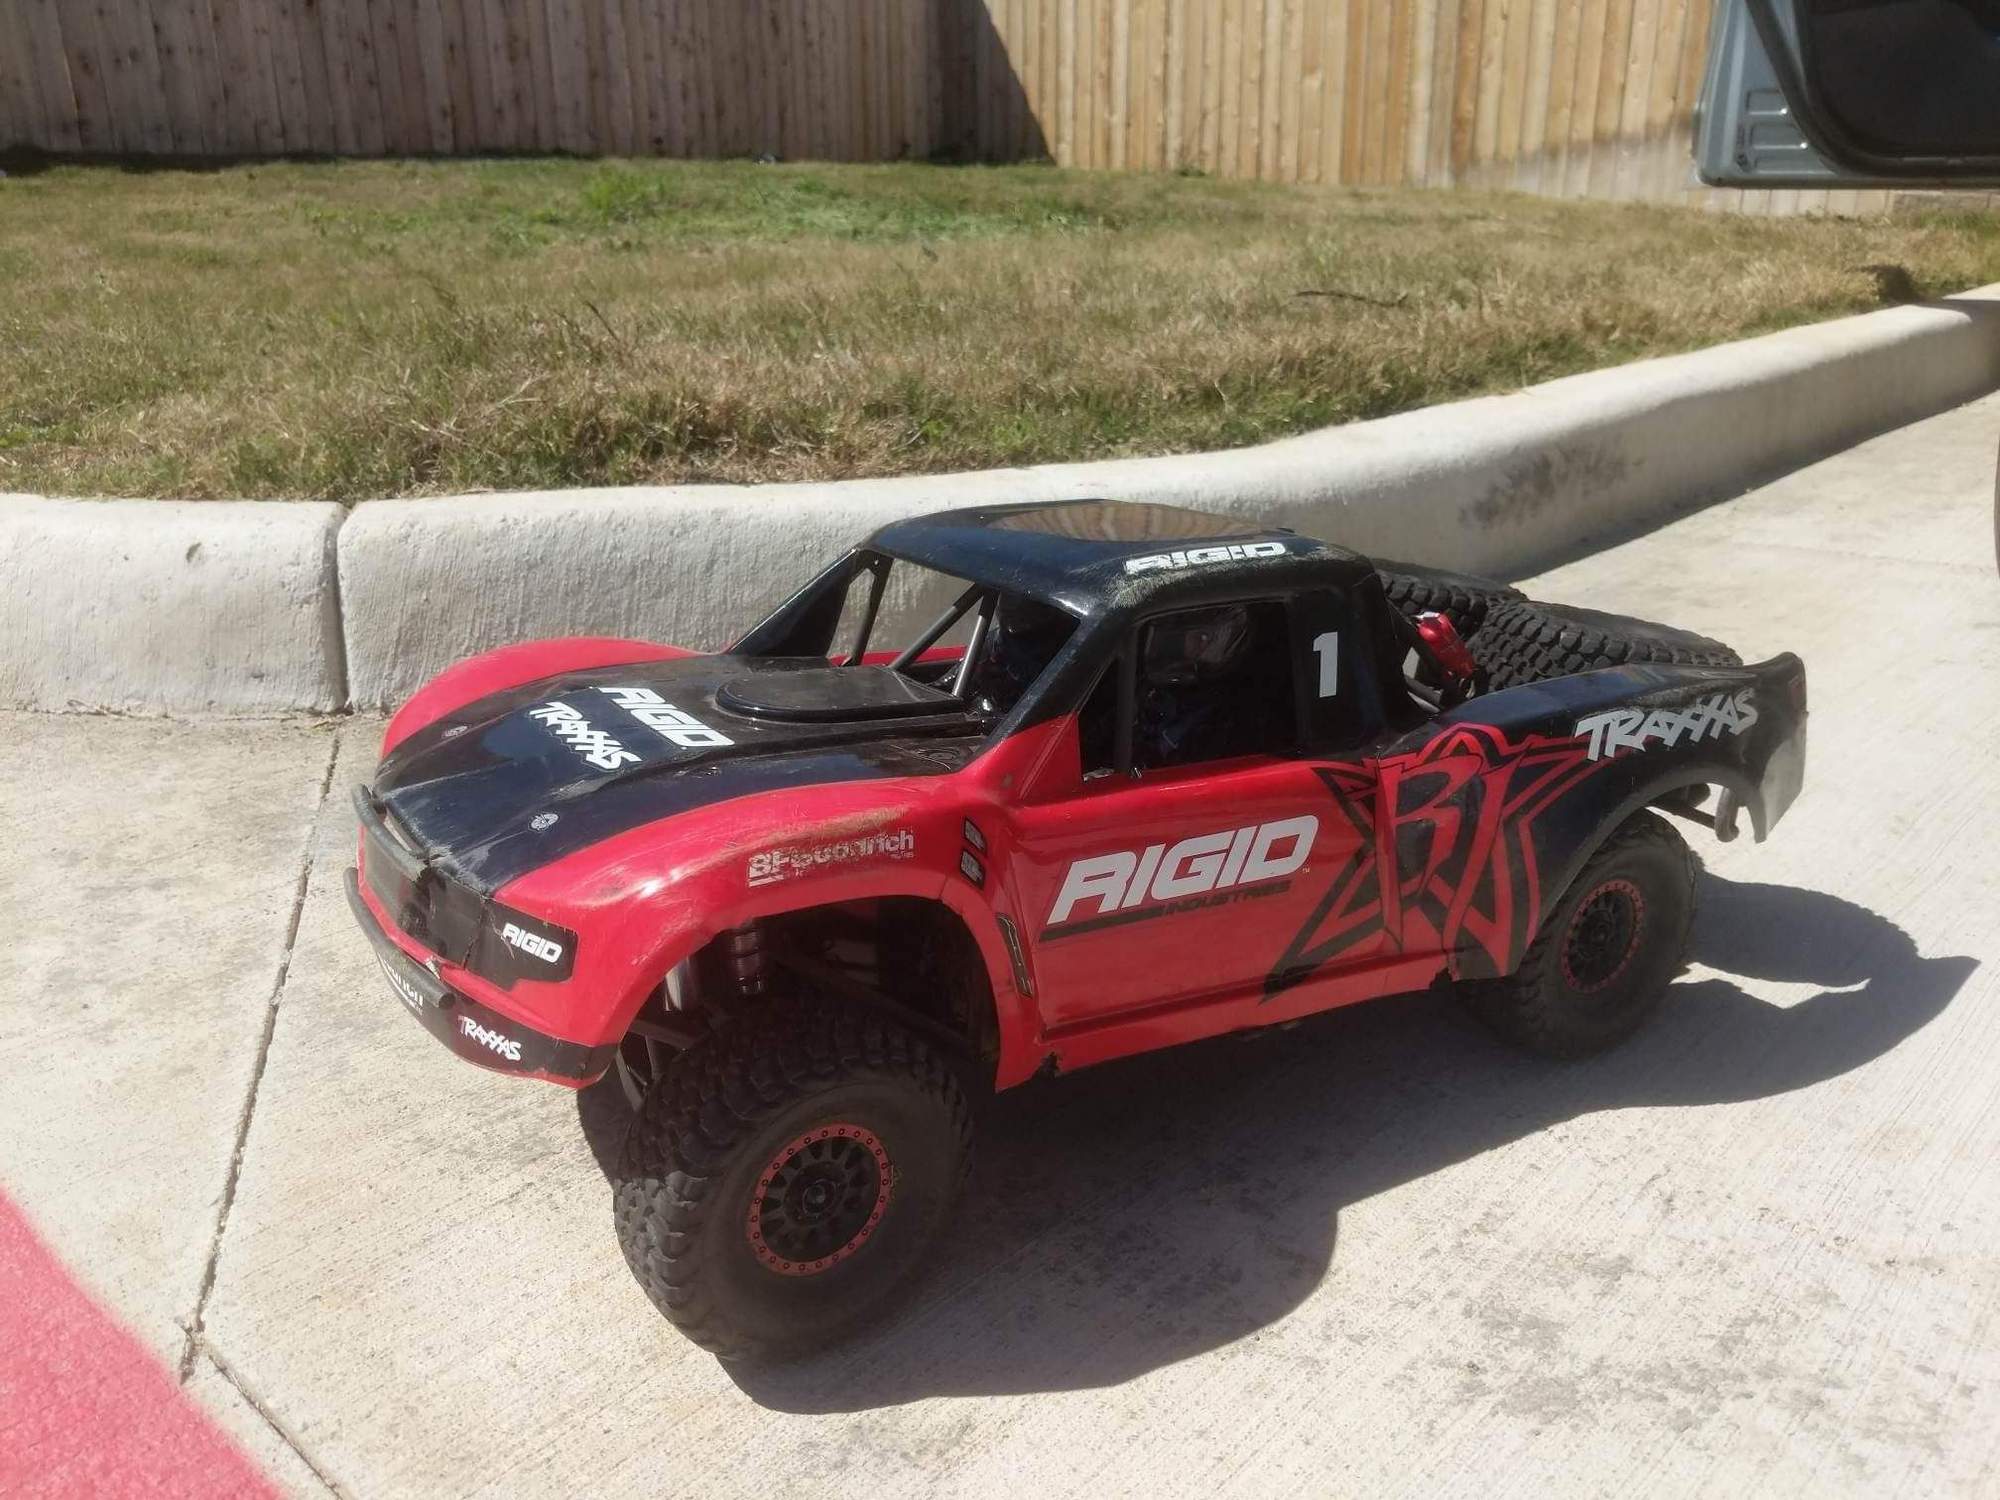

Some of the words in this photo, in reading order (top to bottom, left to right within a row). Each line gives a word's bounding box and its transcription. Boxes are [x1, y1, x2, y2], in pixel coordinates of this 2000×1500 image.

[1125, 542, 1286, 574] RIGID
[1313, 631, 1338, 697] 1
[529, 701, 643, 769] TRAXXAS
[599, 687, 735, 746] RIGID
[1574, 687, 1758, 762] TRAXXAS
[1046, 814, 1319, 926] RIGID
[501, 922, 563, 963] RIGID
[458, 1015, 522, 1061] TRAXXAS
